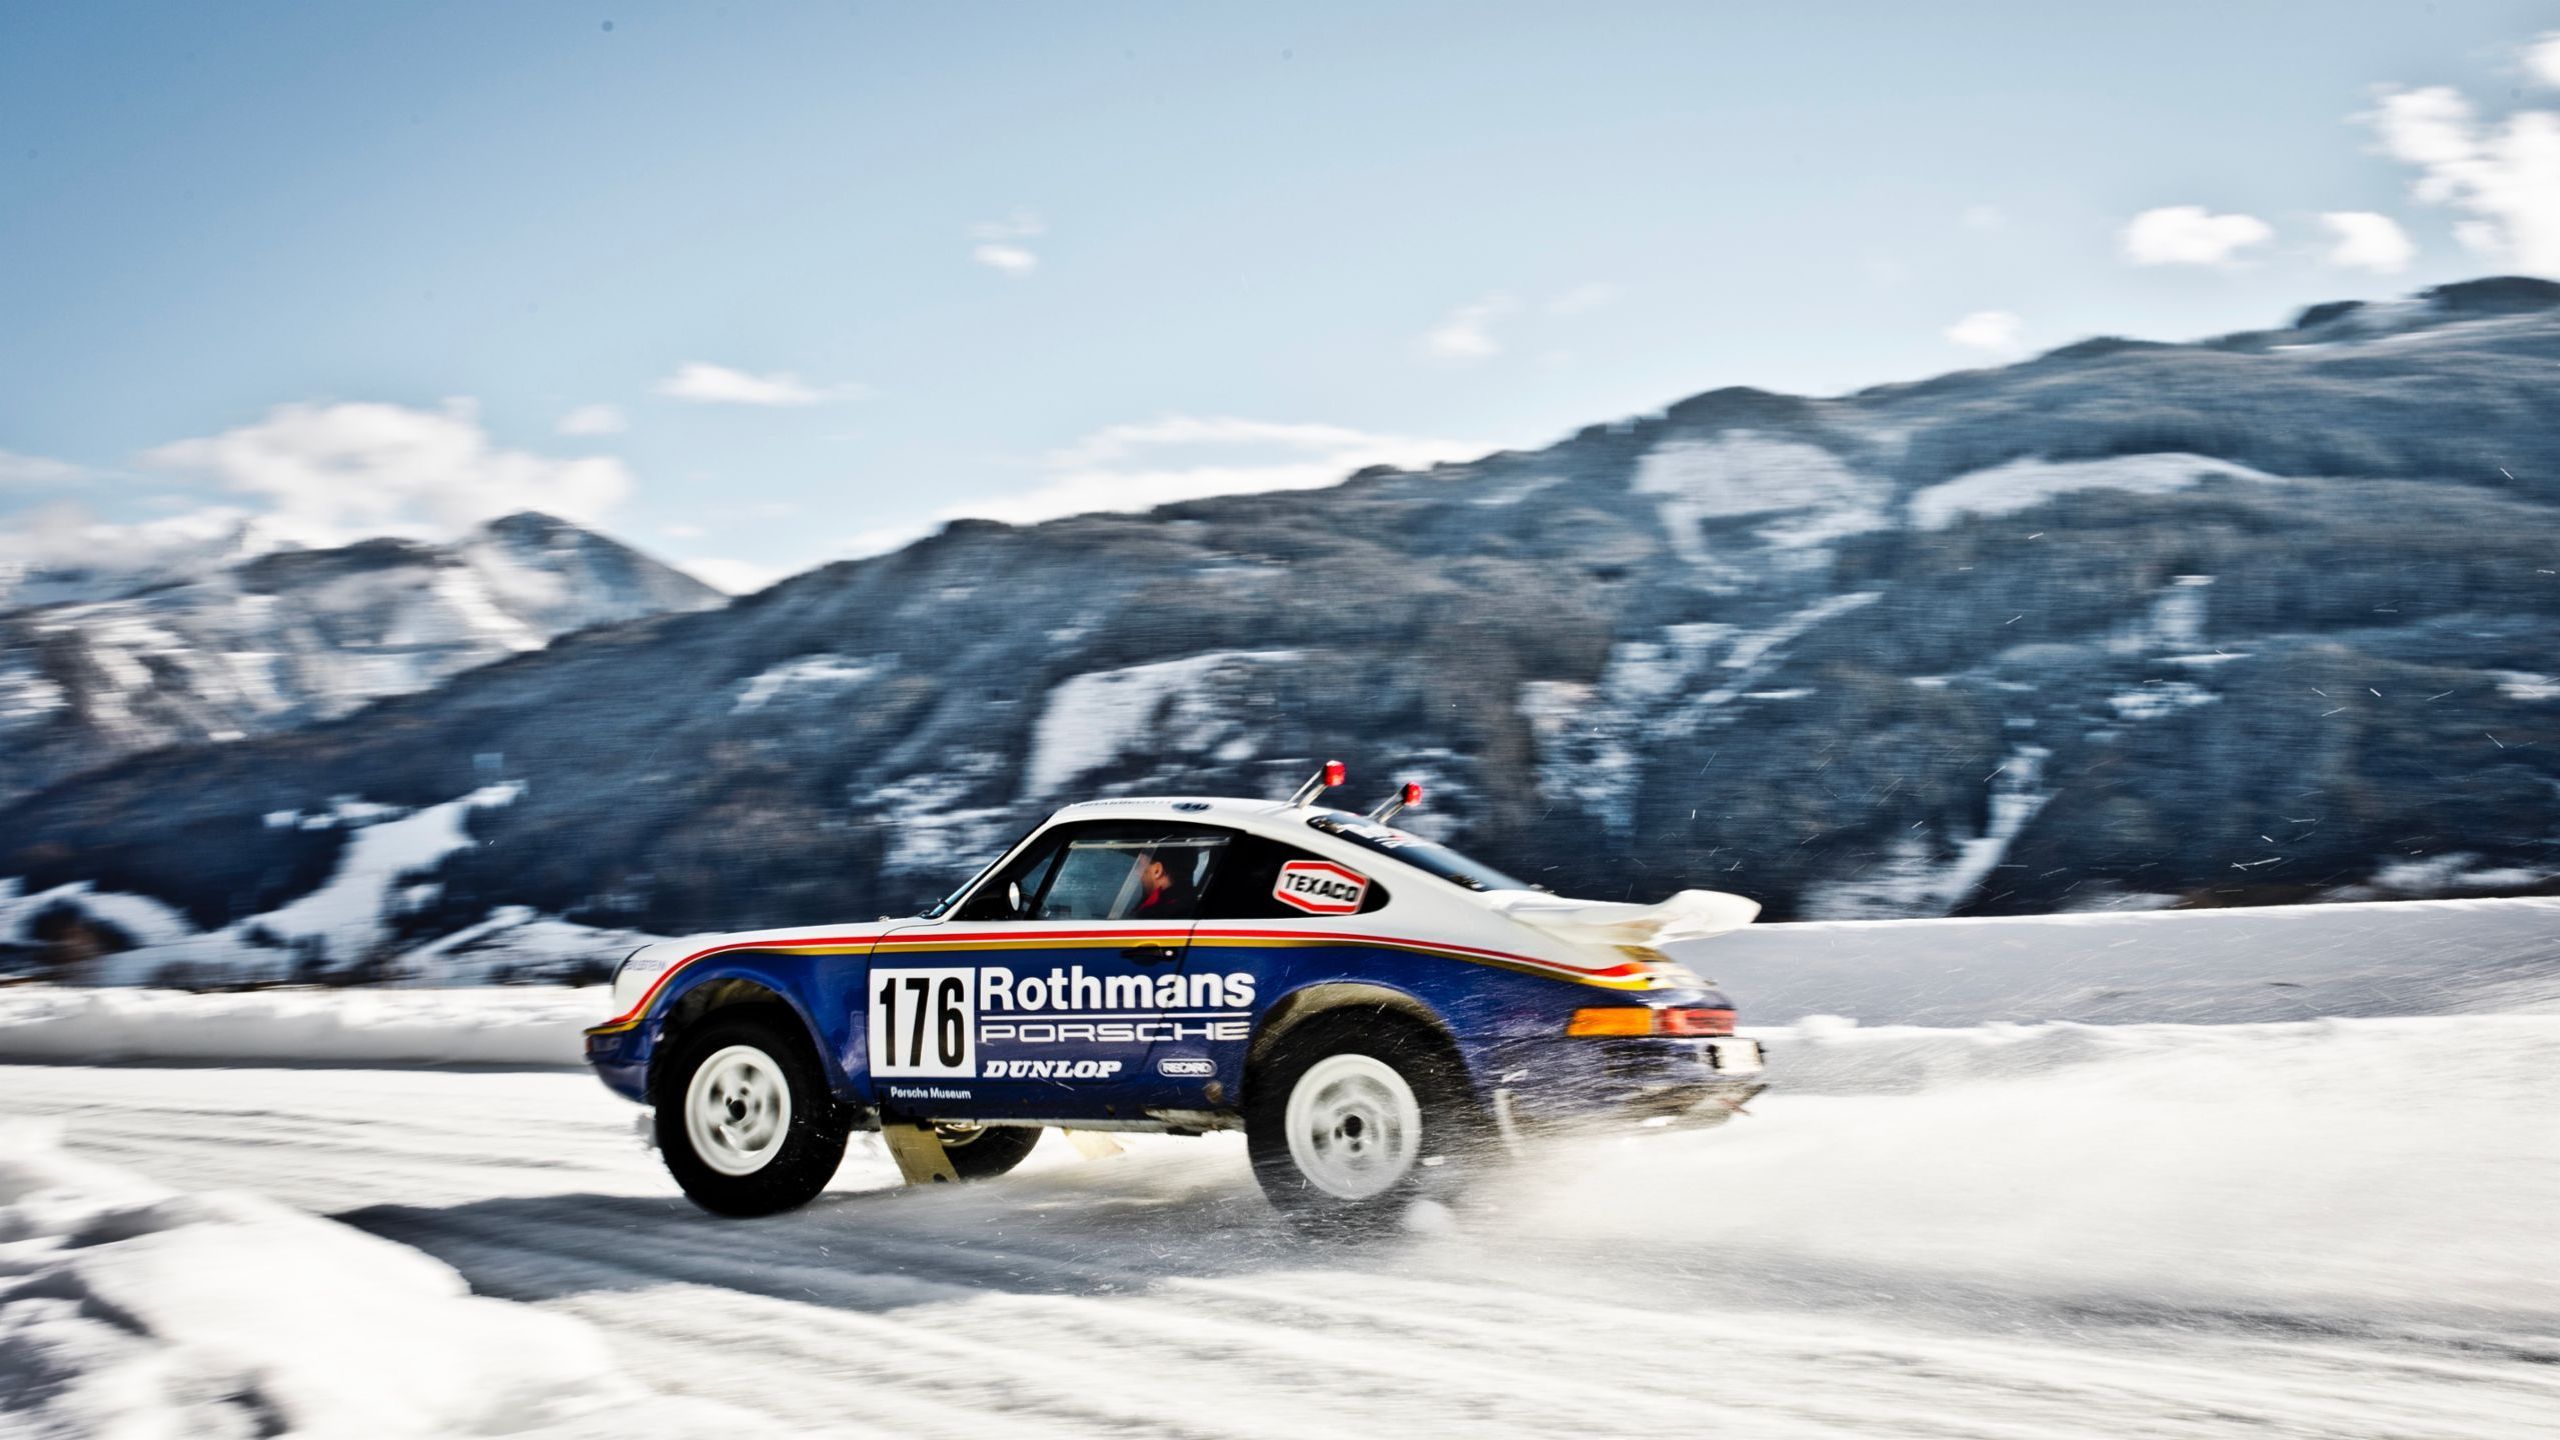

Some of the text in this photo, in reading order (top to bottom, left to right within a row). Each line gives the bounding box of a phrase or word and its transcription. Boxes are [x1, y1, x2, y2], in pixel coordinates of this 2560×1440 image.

[1284, 872, 1359, 903] TEXACO
[980, 965, 1256, 1011] Rothmans
[879, 976, 967, 1069] 176
[980, 1022, 1251, 1043] PORSCHE
[983, 1060, 1122, 1078] DUNLOP
[890, 1086, 972, 1100] Porsche Museum
